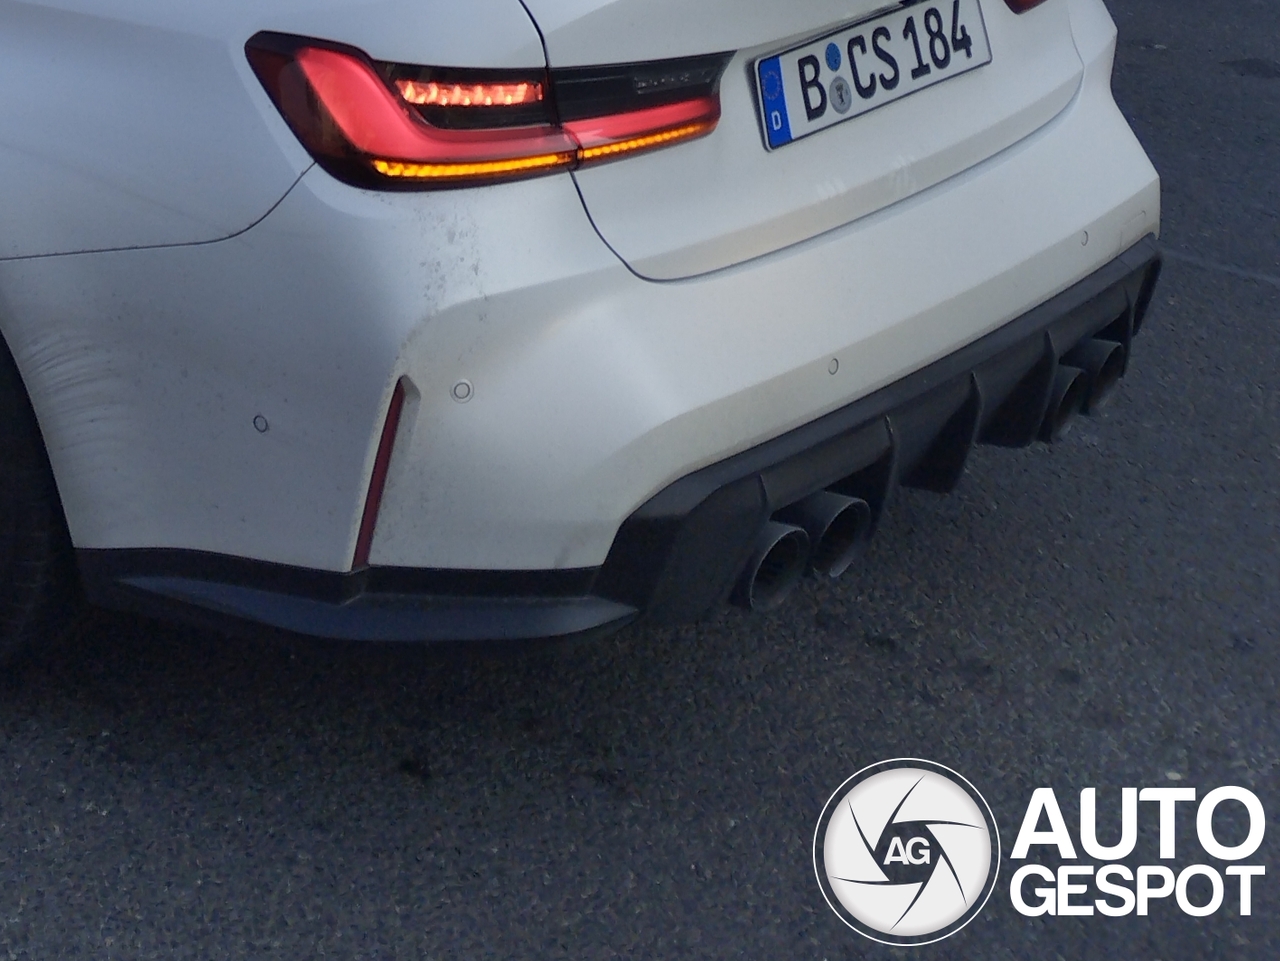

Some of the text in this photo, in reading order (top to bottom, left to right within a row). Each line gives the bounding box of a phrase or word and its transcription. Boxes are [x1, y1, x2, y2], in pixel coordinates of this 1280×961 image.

[797, 53, 828, 122] B
[847, 26, 900, 100] CS
[771, 110, 782, 131] D
